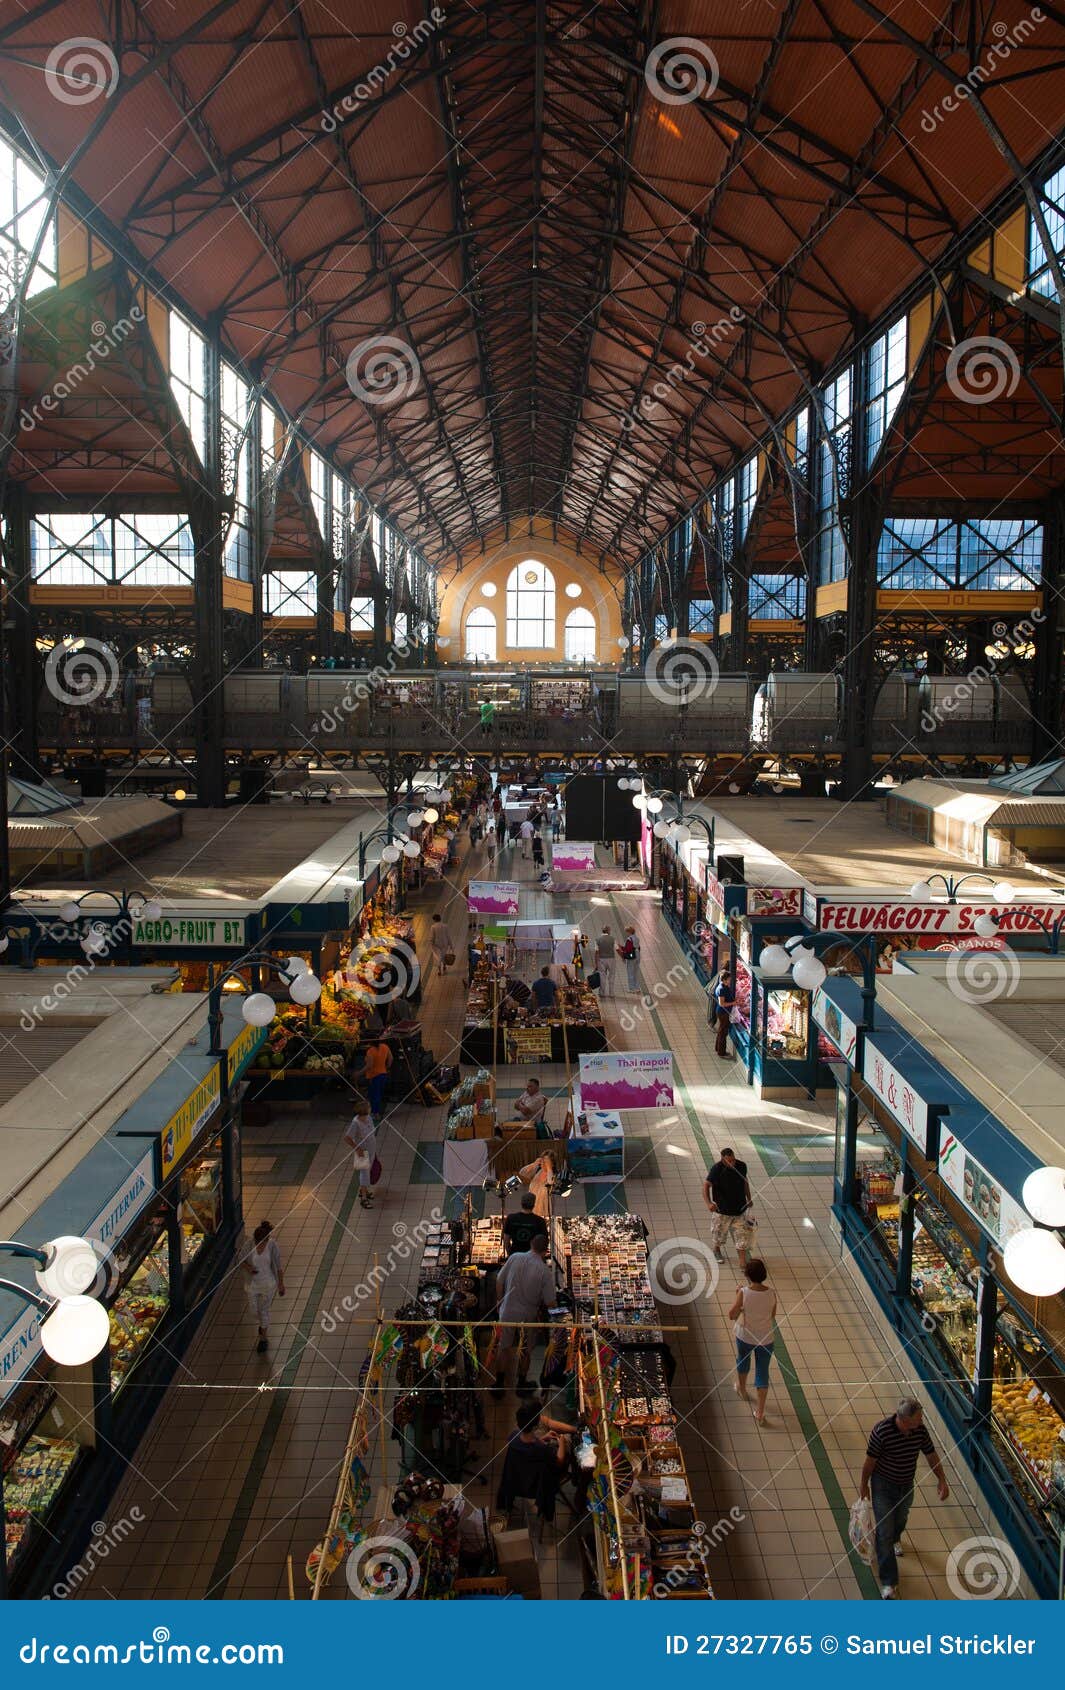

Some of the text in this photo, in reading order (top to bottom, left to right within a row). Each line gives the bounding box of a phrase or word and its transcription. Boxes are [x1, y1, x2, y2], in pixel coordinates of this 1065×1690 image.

[822, 905, 950, 930] FELVÁGOTT
[135, 921, 242, 944] AGRO-FRUIT BT.
[617, 1057, 669, 1068] Thai napok
[100, 1172, 145, 1242] TEJTERMÉK
[0, 1313, 42, 1379] RENC
